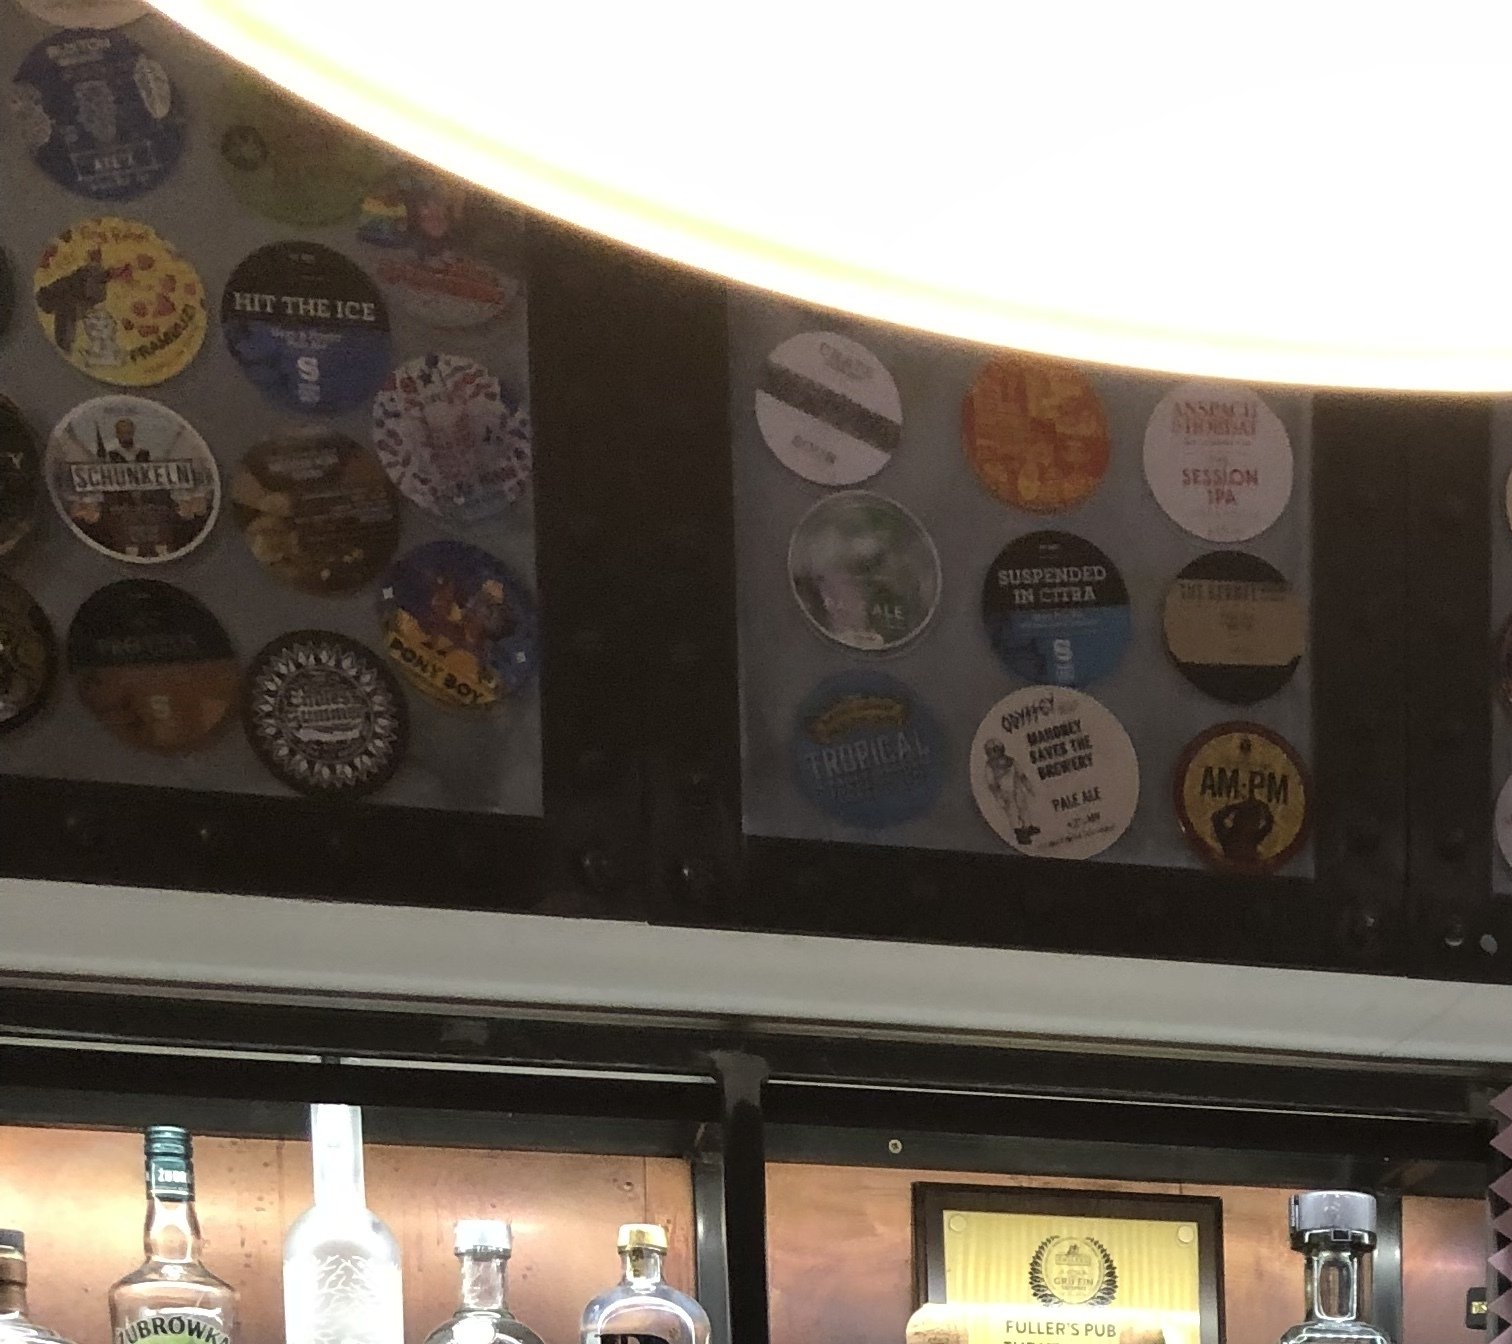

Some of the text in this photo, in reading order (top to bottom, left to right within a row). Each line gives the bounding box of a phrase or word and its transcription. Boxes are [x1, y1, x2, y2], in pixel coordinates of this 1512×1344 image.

[233, 291, 376, 323] HIT THE ICE
[74, 463, 192, 491] SCHUNKELN
[1181, 468, 1260, 488] SESSION
[1207, 487, 1238, 507] IPA
[997, 567, 1107, 584] SUSPENDED
[1013, 588, 1035, 603] IN
[388, 636, 485, 704] PONY BOY
[1069, 734, 1093, 752] THE
[805, 730, 930, 780] TROPICAL
[1051, 792, 1080, 812] PALE
[1005, 1320, 1116, 1337] FULLER'S PUB
